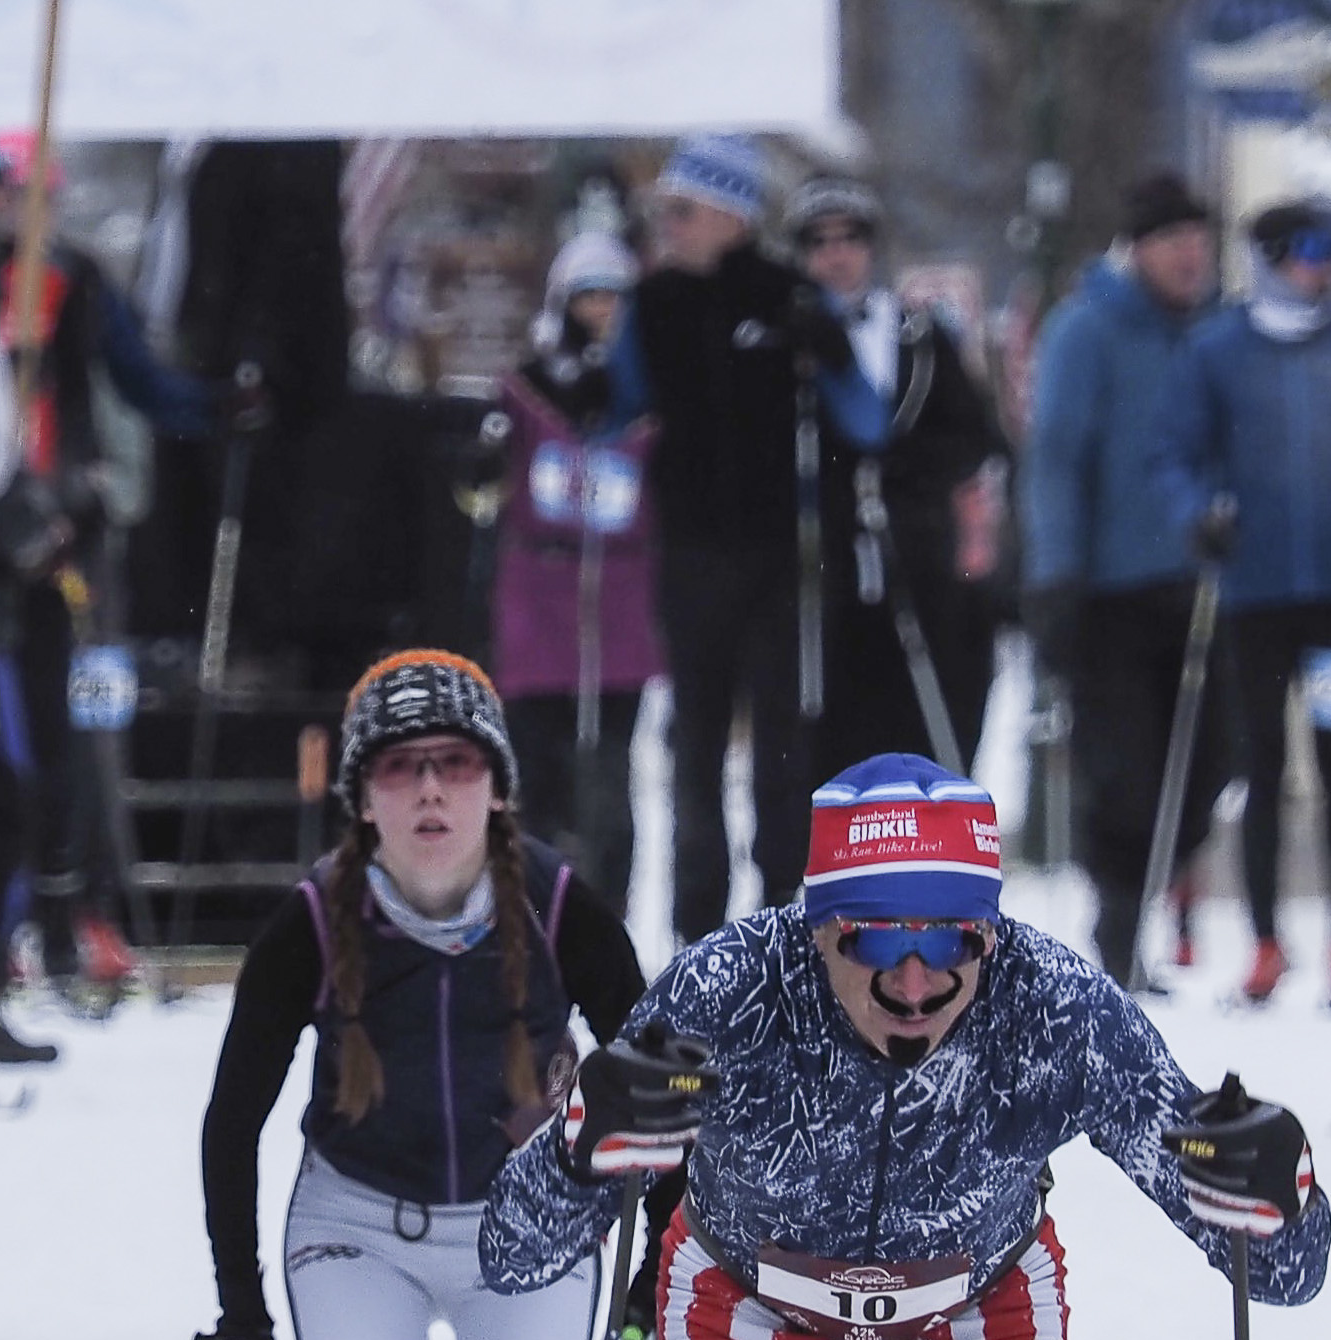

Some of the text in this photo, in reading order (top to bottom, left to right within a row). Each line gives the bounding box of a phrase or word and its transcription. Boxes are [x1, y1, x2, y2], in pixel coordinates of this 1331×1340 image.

[848, 818, 919, 845] BIRKIE
[830, 1290, 897, 1322] 10
[850, 1325, 876, 1338] 42K
